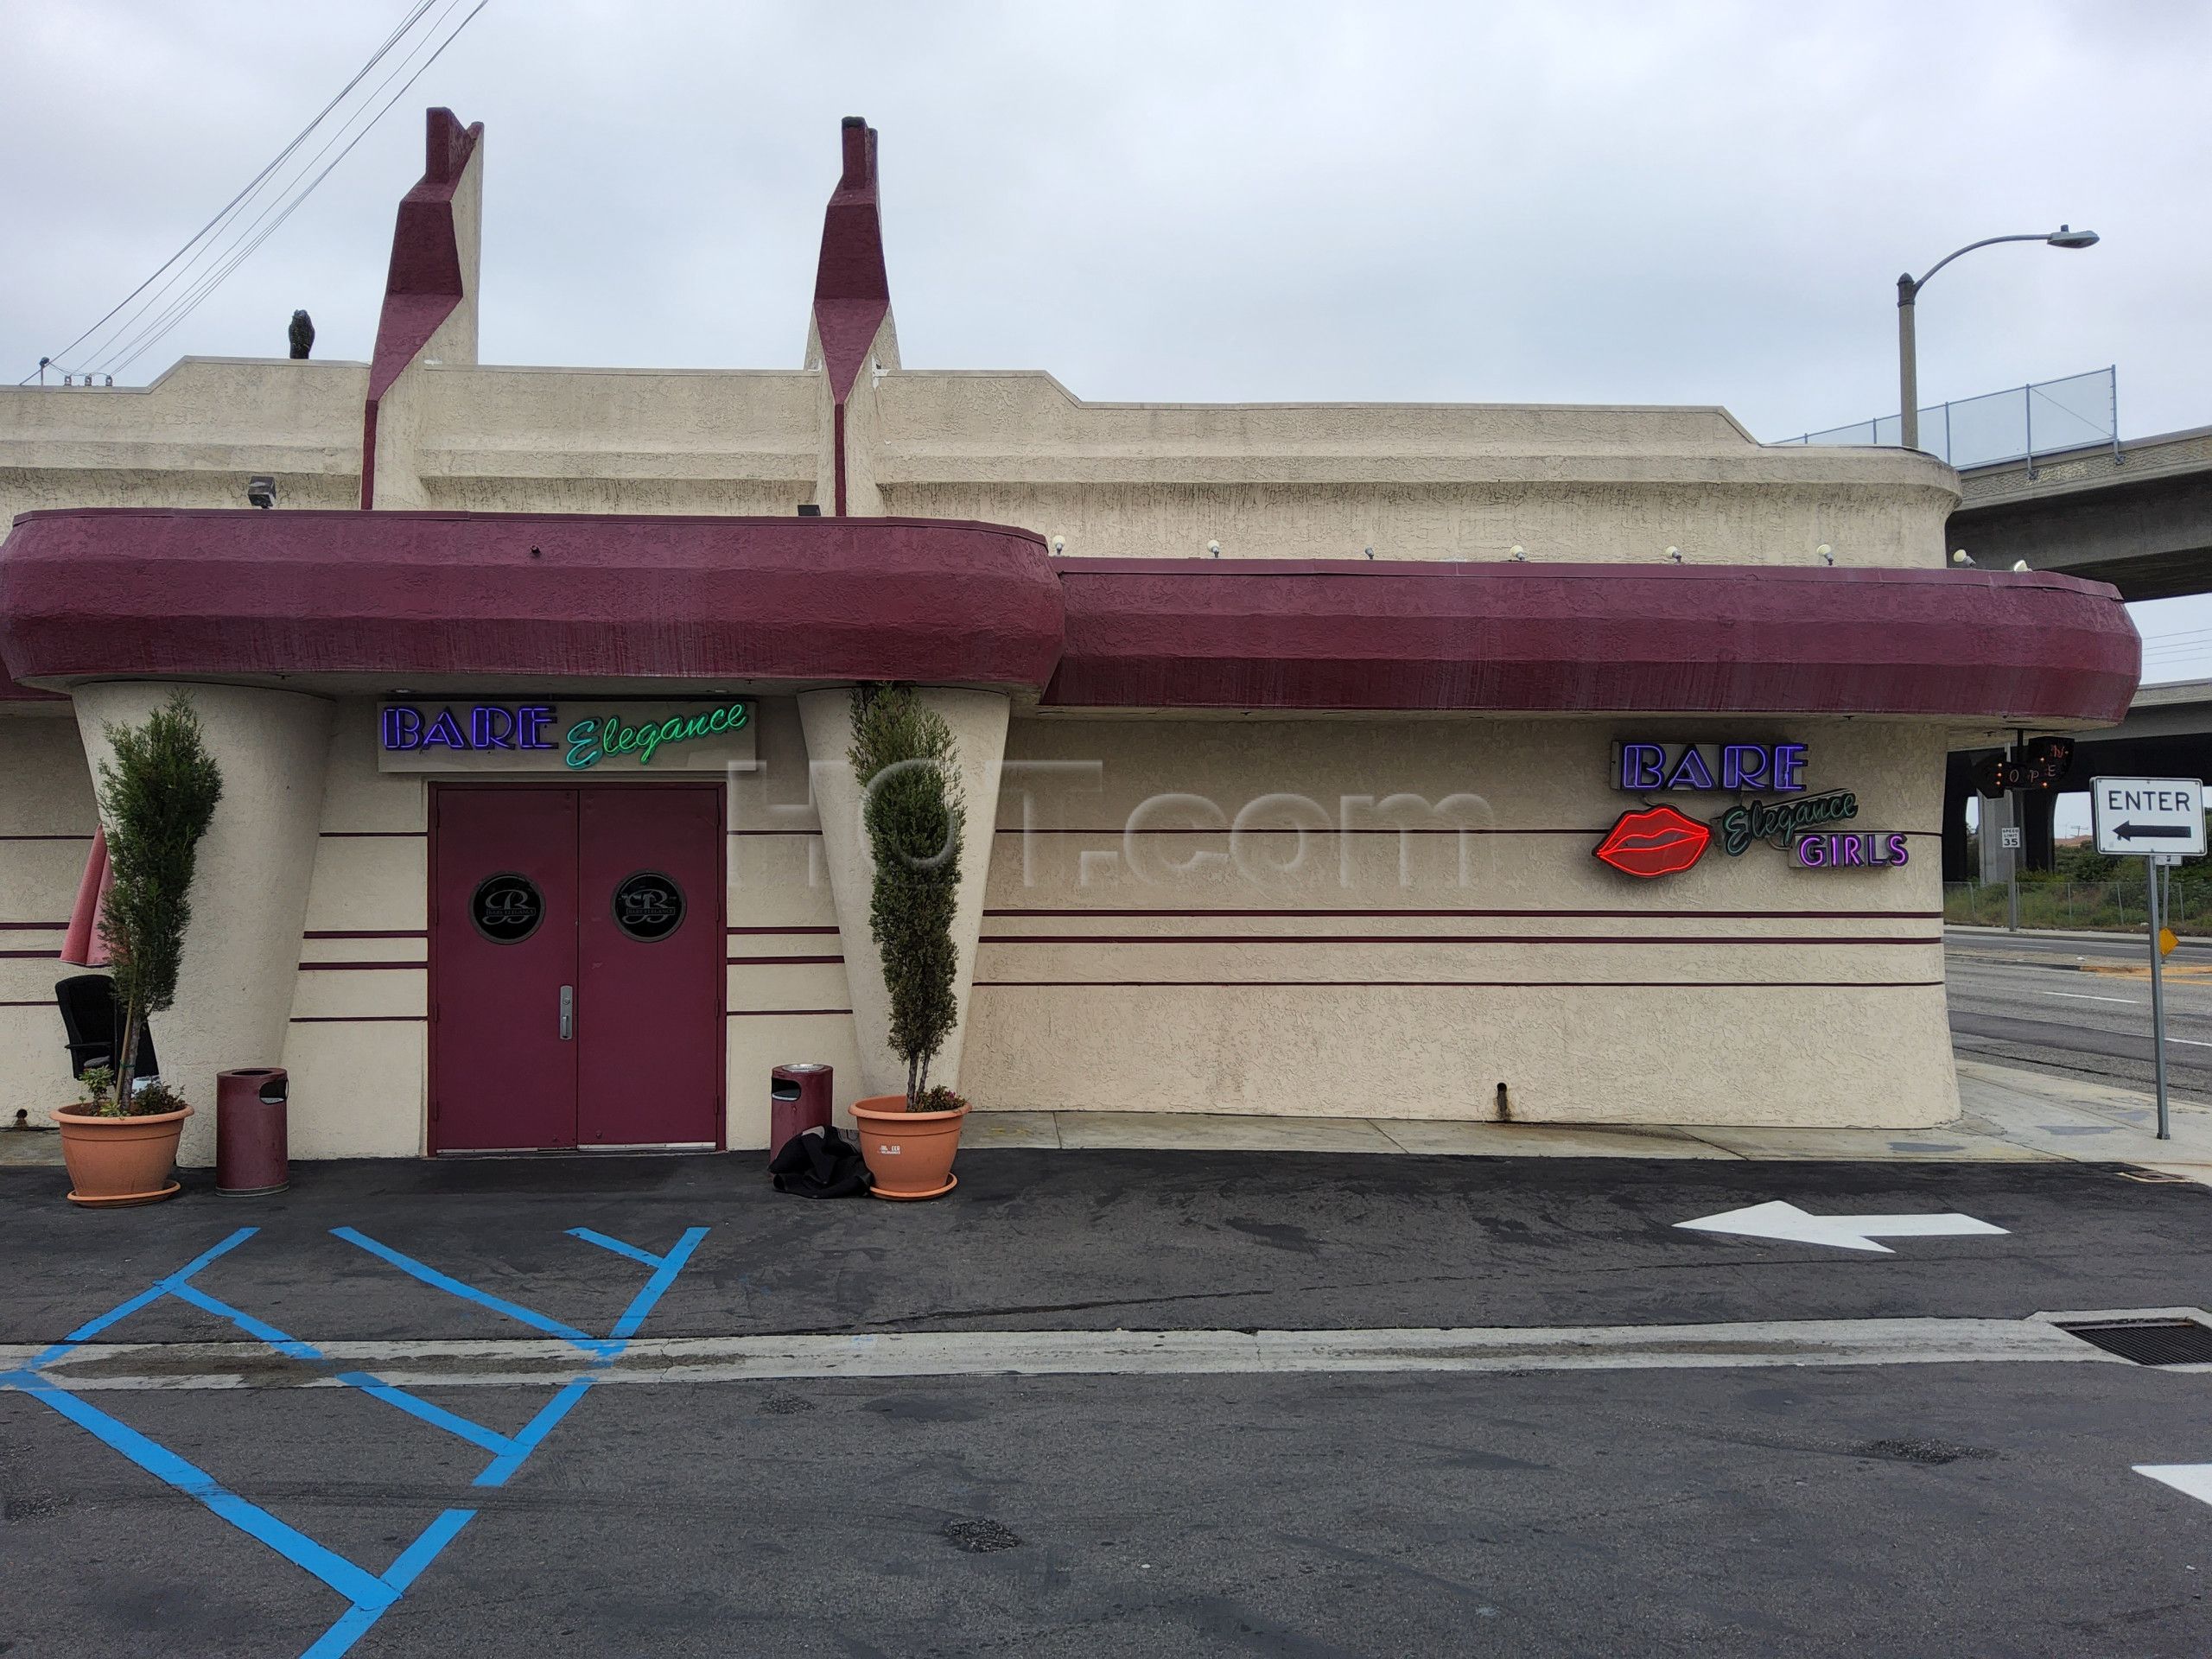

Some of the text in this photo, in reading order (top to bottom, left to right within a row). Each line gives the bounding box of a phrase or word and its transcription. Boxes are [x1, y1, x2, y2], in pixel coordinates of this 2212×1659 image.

[383, 702, 750, 770] BARE Elegance
[1622, 742, 1808, 791] BARE
[1722, 792, 1859, 856] Elegance
[2108, 790, 2190, 811] ENTER
[1798, 833, 1910, 868] GIRLS
